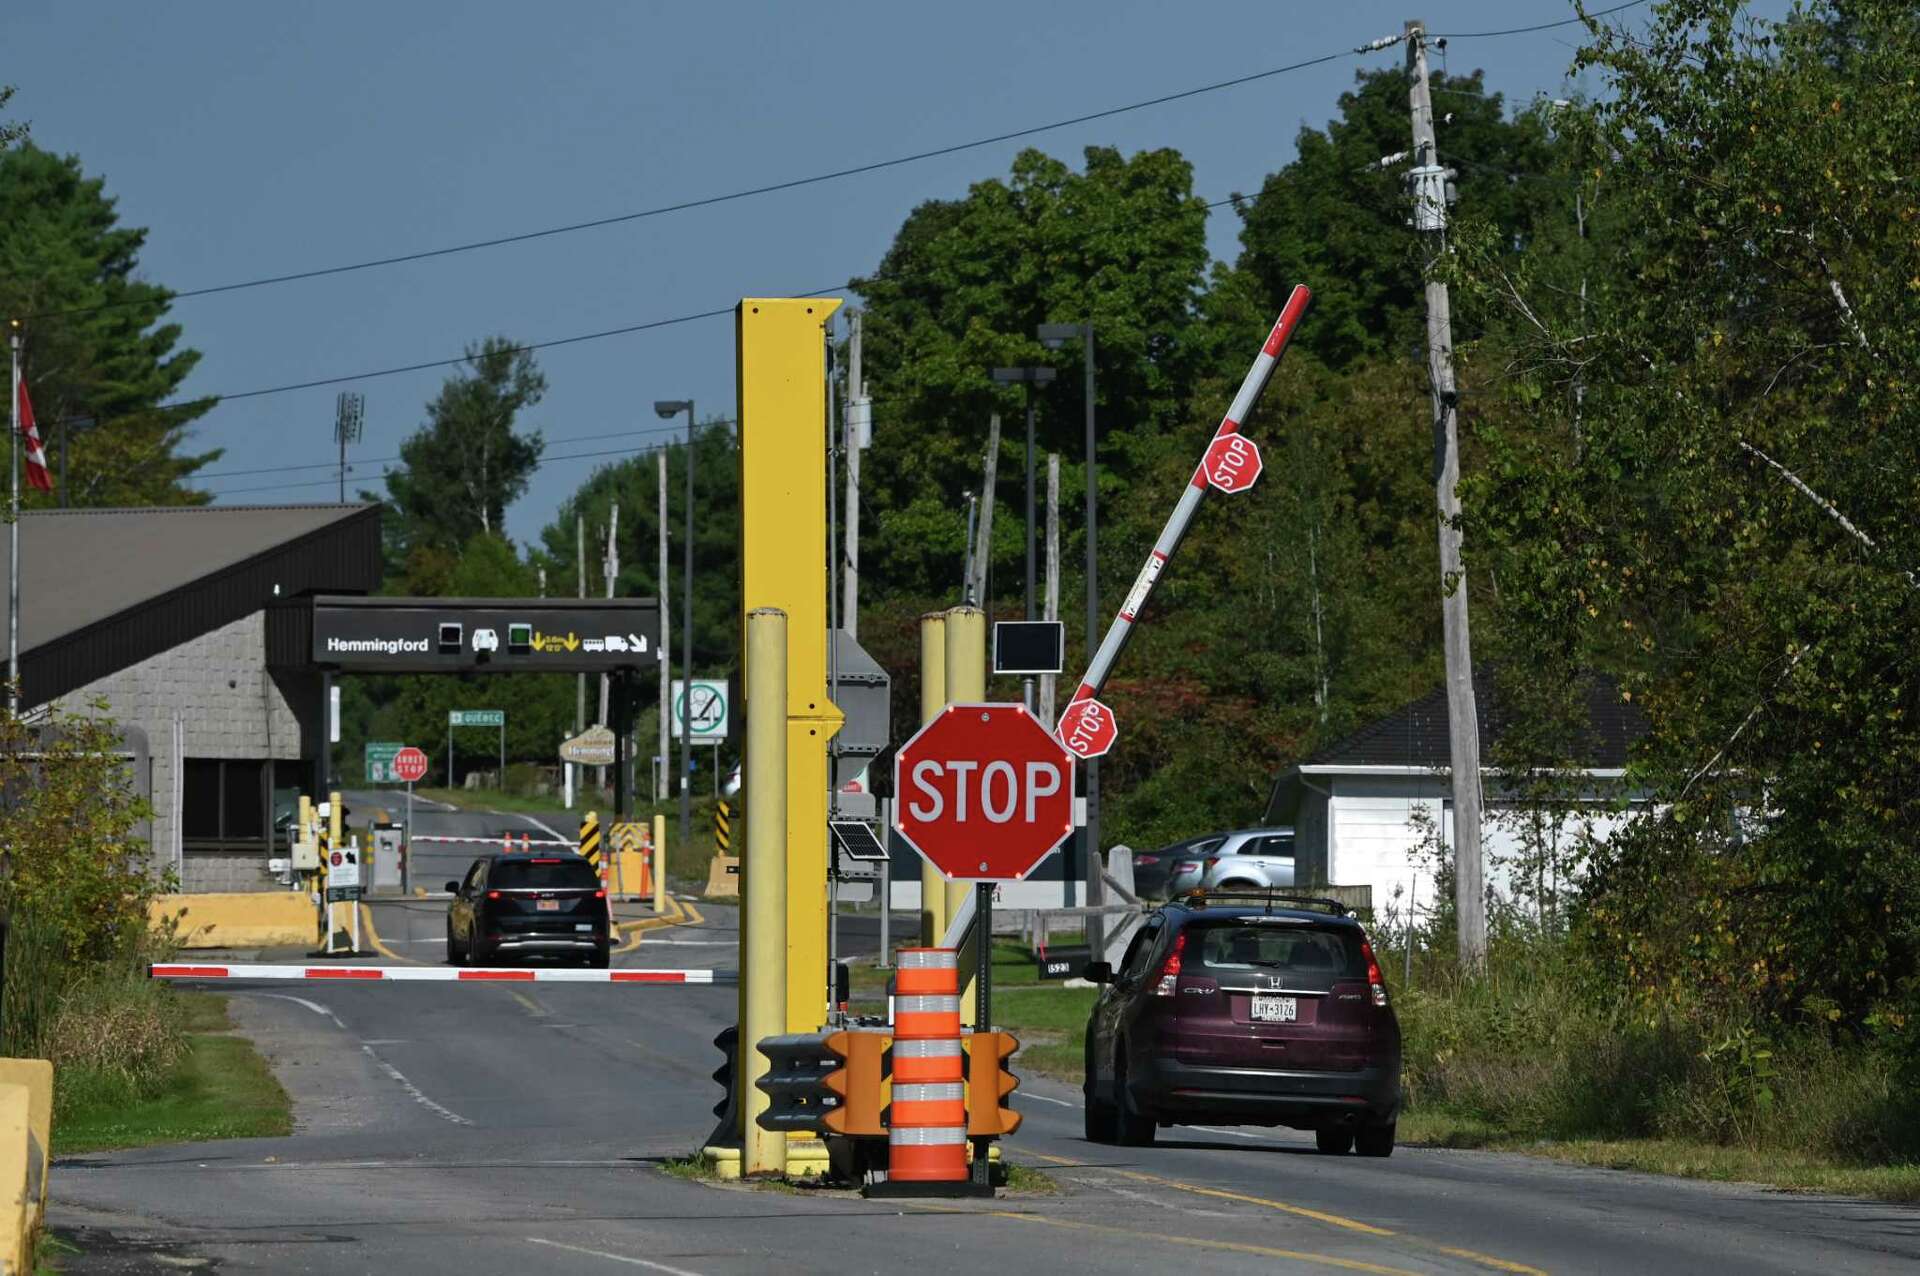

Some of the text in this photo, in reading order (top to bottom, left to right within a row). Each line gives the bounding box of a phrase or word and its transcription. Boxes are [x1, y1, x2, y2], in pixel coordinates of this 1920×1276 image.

[1214, 438, 1249, 488] STOP
[327, 637, 429, 654] Hemmingford
[1069, 703, 1105, 753] STOP
[909, 759, 1062, 824] STOP
[1253, 1002, 1294, 1017] LHY-3126
